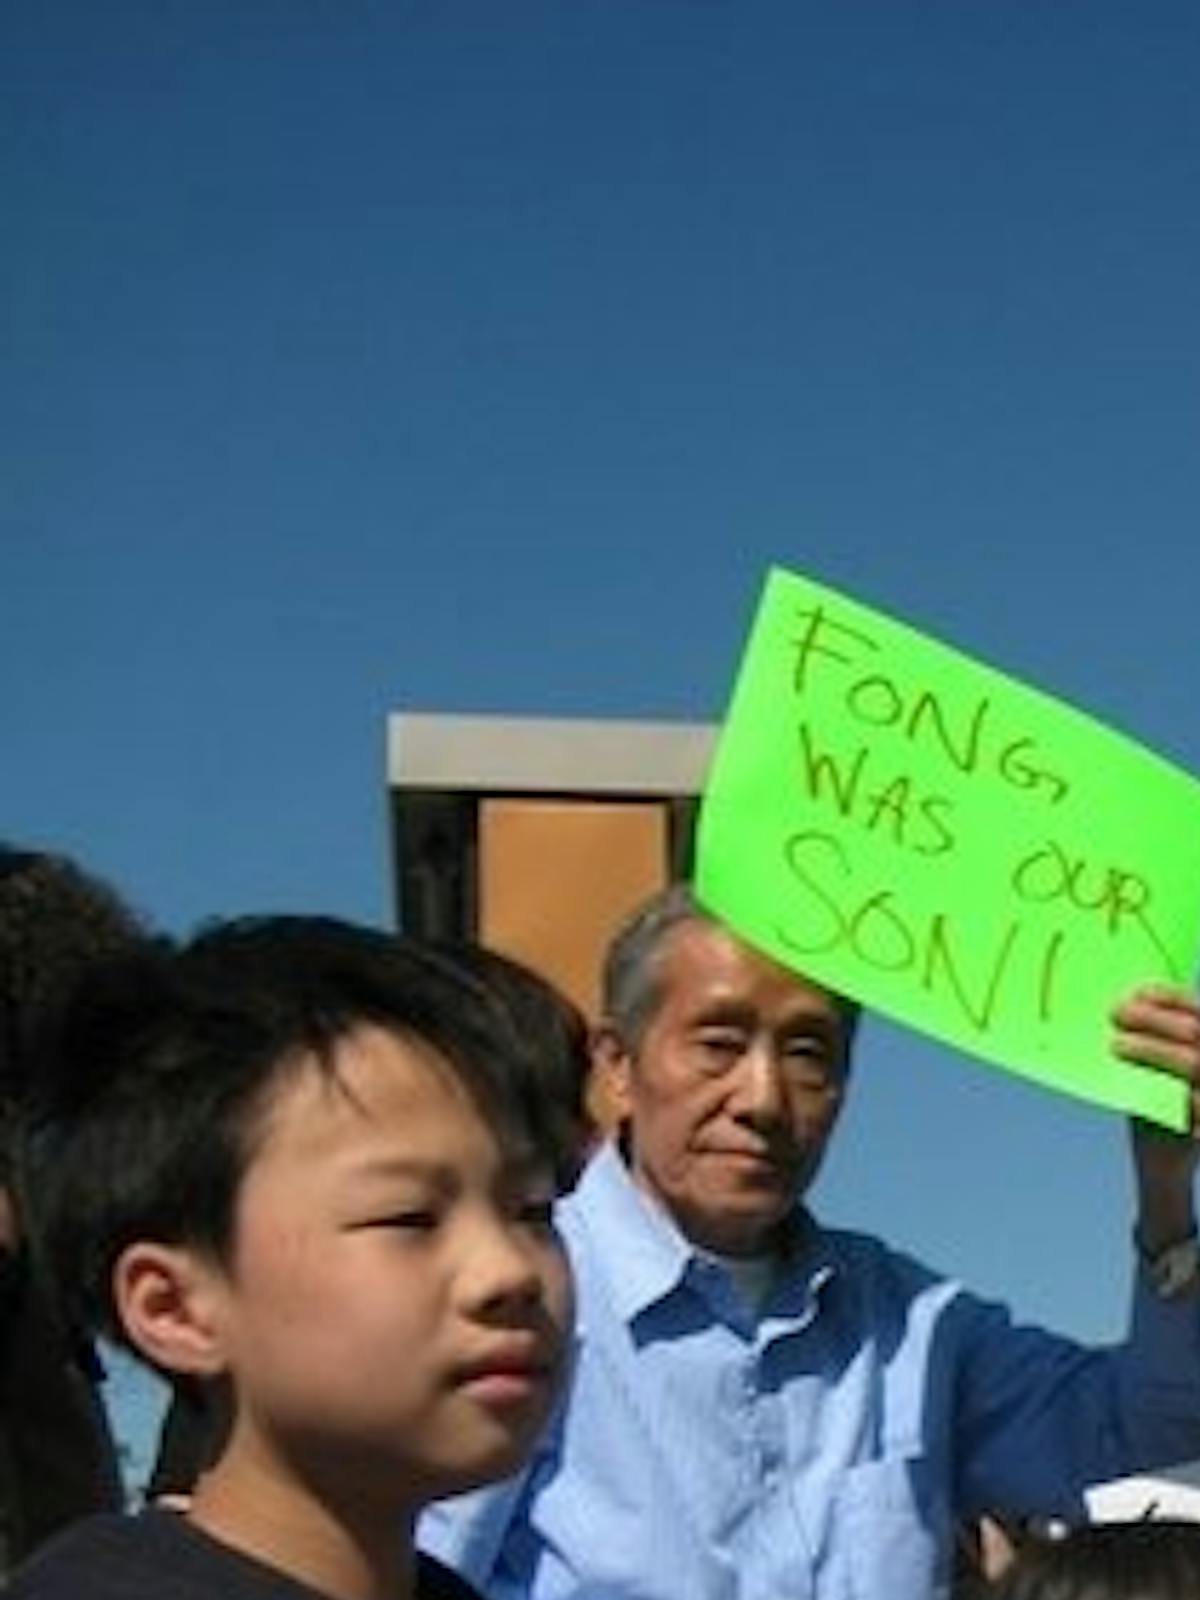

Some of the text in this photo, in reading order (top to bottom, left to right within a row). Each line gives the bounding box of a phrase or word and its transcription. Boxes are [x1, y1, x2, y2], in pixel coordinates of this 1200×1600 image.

[775, 830, 1064, 1035] SON!
[798, 722, 1184, 986] WAS OUR
